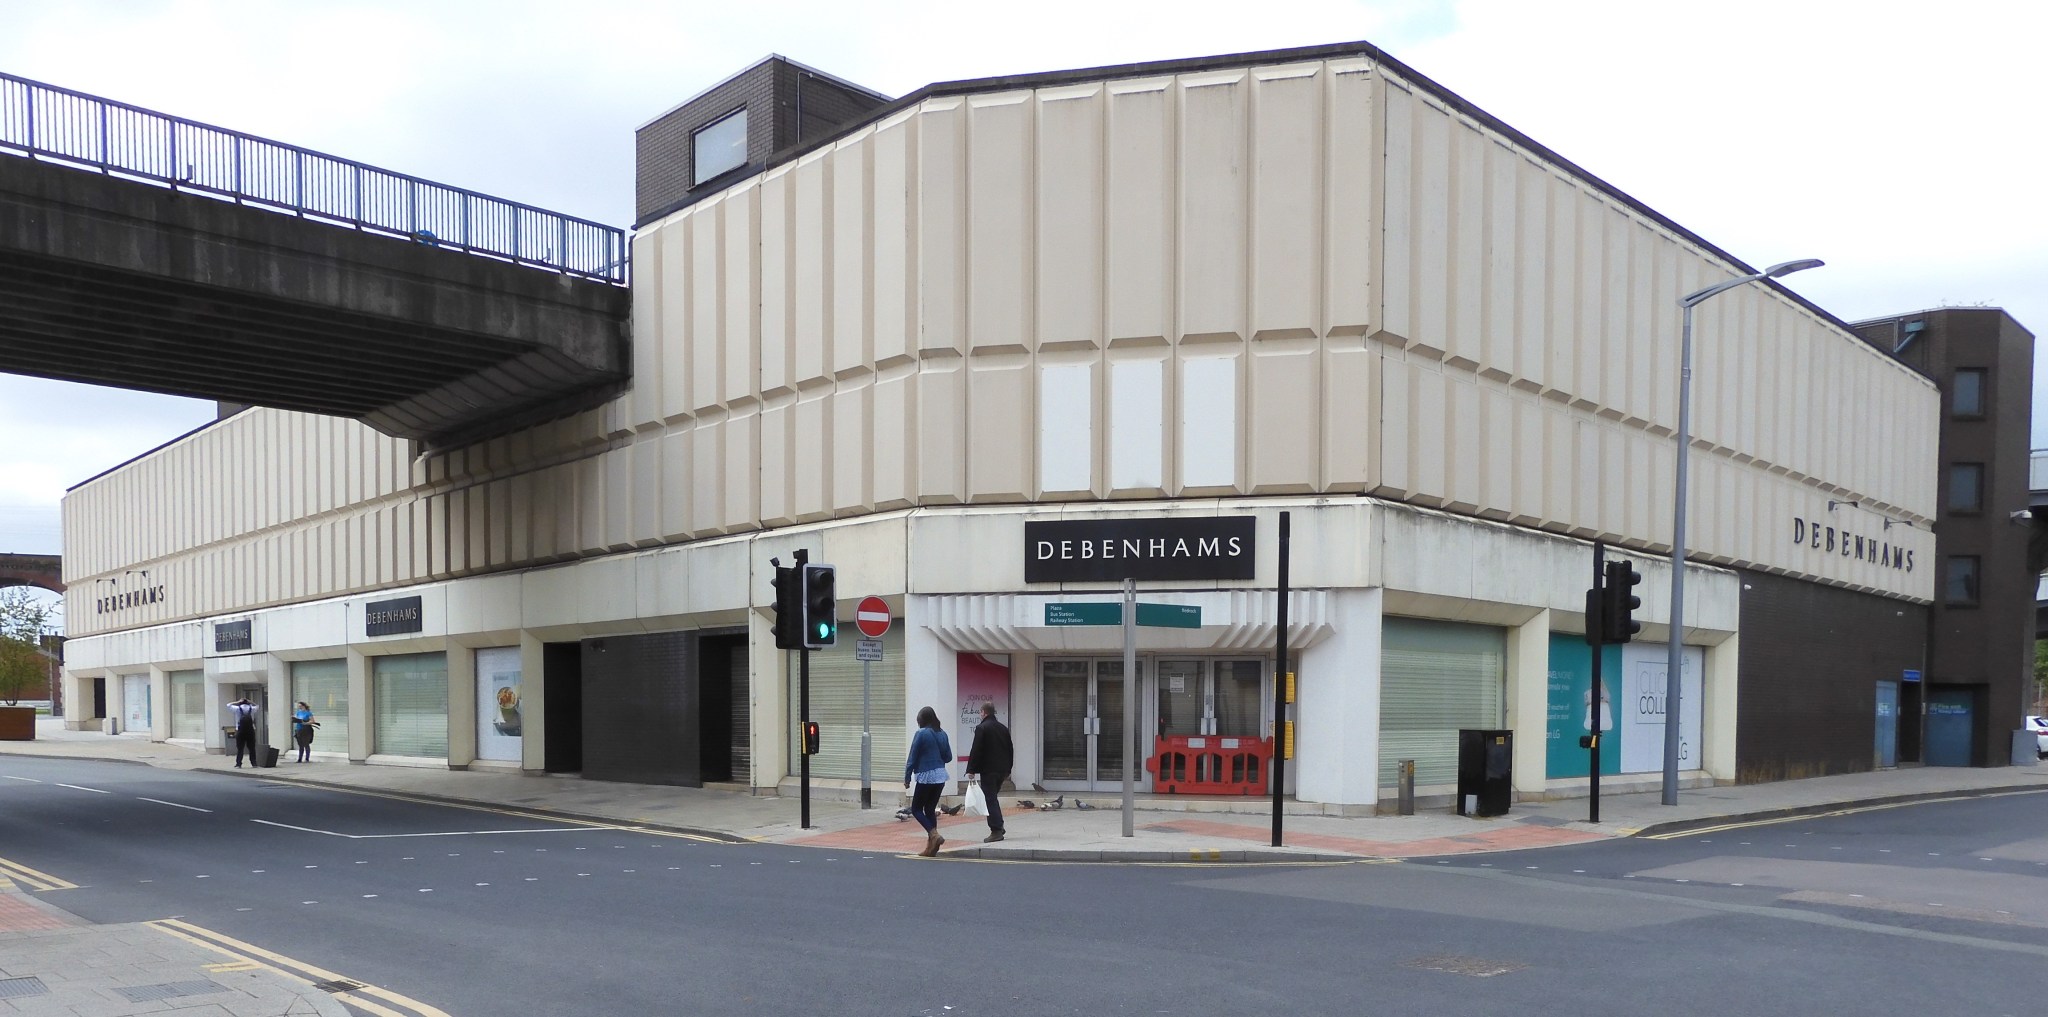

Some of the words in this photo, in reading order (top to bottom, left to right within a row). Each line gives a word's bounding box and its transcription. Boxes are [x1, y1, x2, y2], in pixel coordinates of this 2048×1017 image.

[1037, 536, 1242, 561] DEBENHAMS
[1793, 517, 1915, 573] DEBENHAMS
[97, 584, 165, 615] DEBENHAMS
[366, 607, 418, 626] DEBENHAMS
[215, 627, 249, 644] DEBENHAMS
